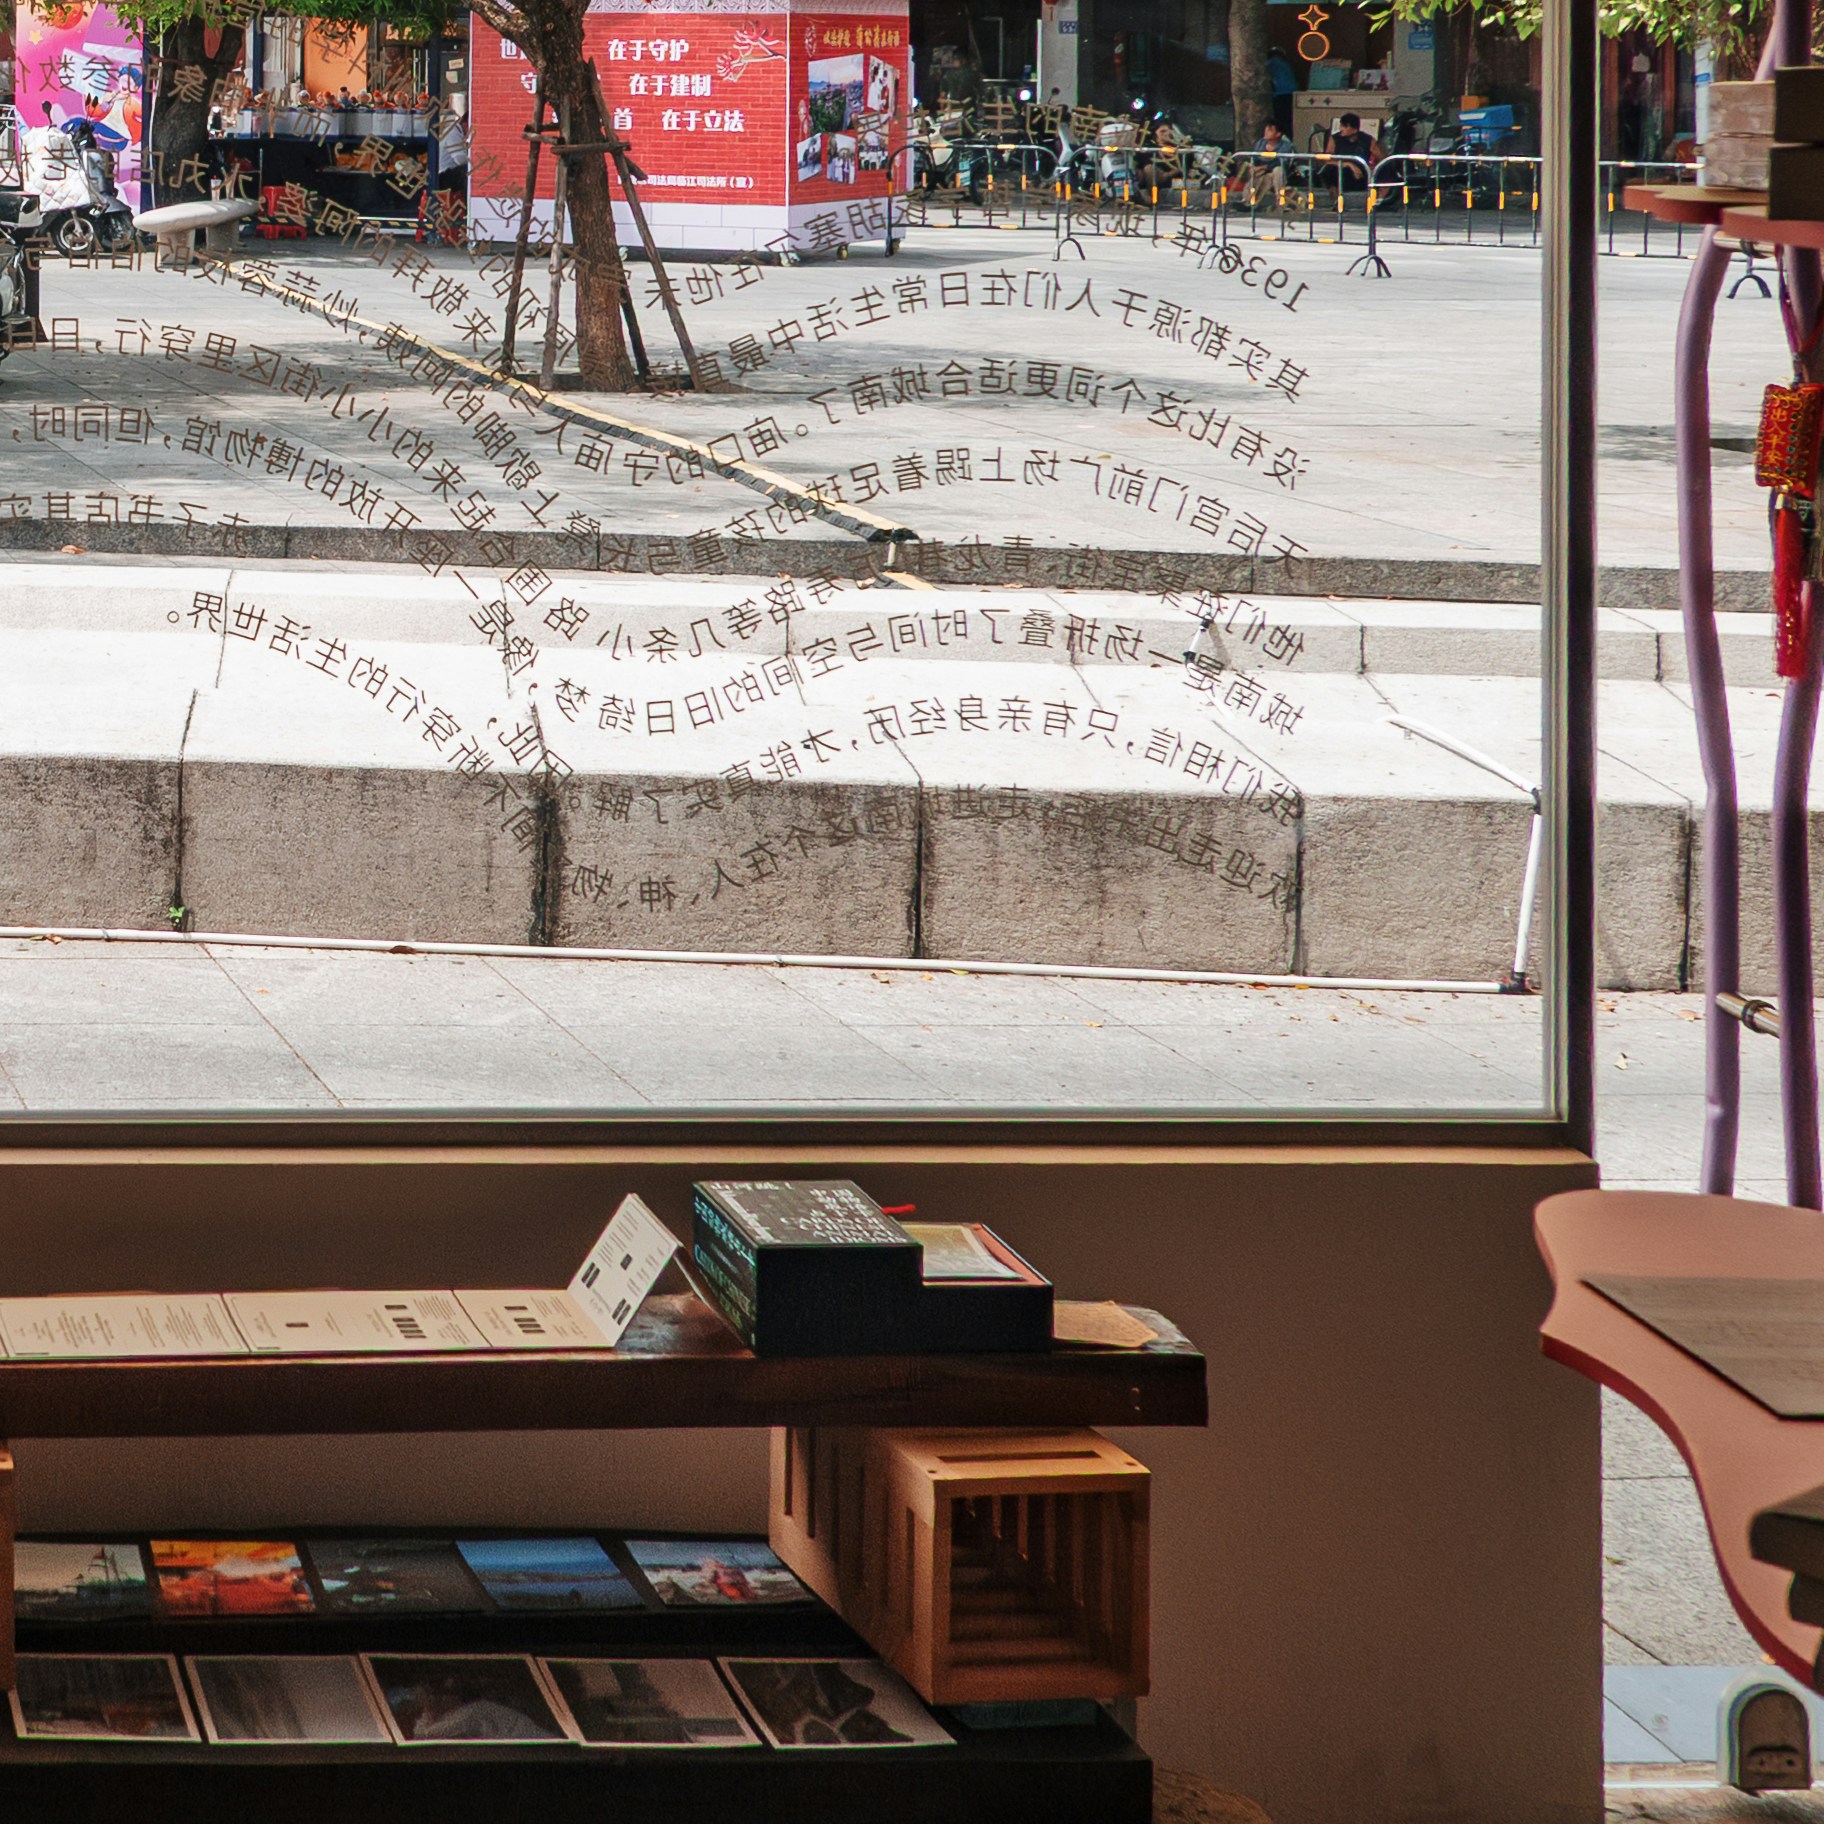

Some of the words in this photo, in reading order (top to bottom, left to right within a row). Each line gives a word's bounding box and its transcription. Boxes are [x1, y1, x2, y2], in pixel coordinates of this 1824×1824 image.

[607, 38, 690, 62] 在于守护
[629, 72, 712, 98] 在于建制
